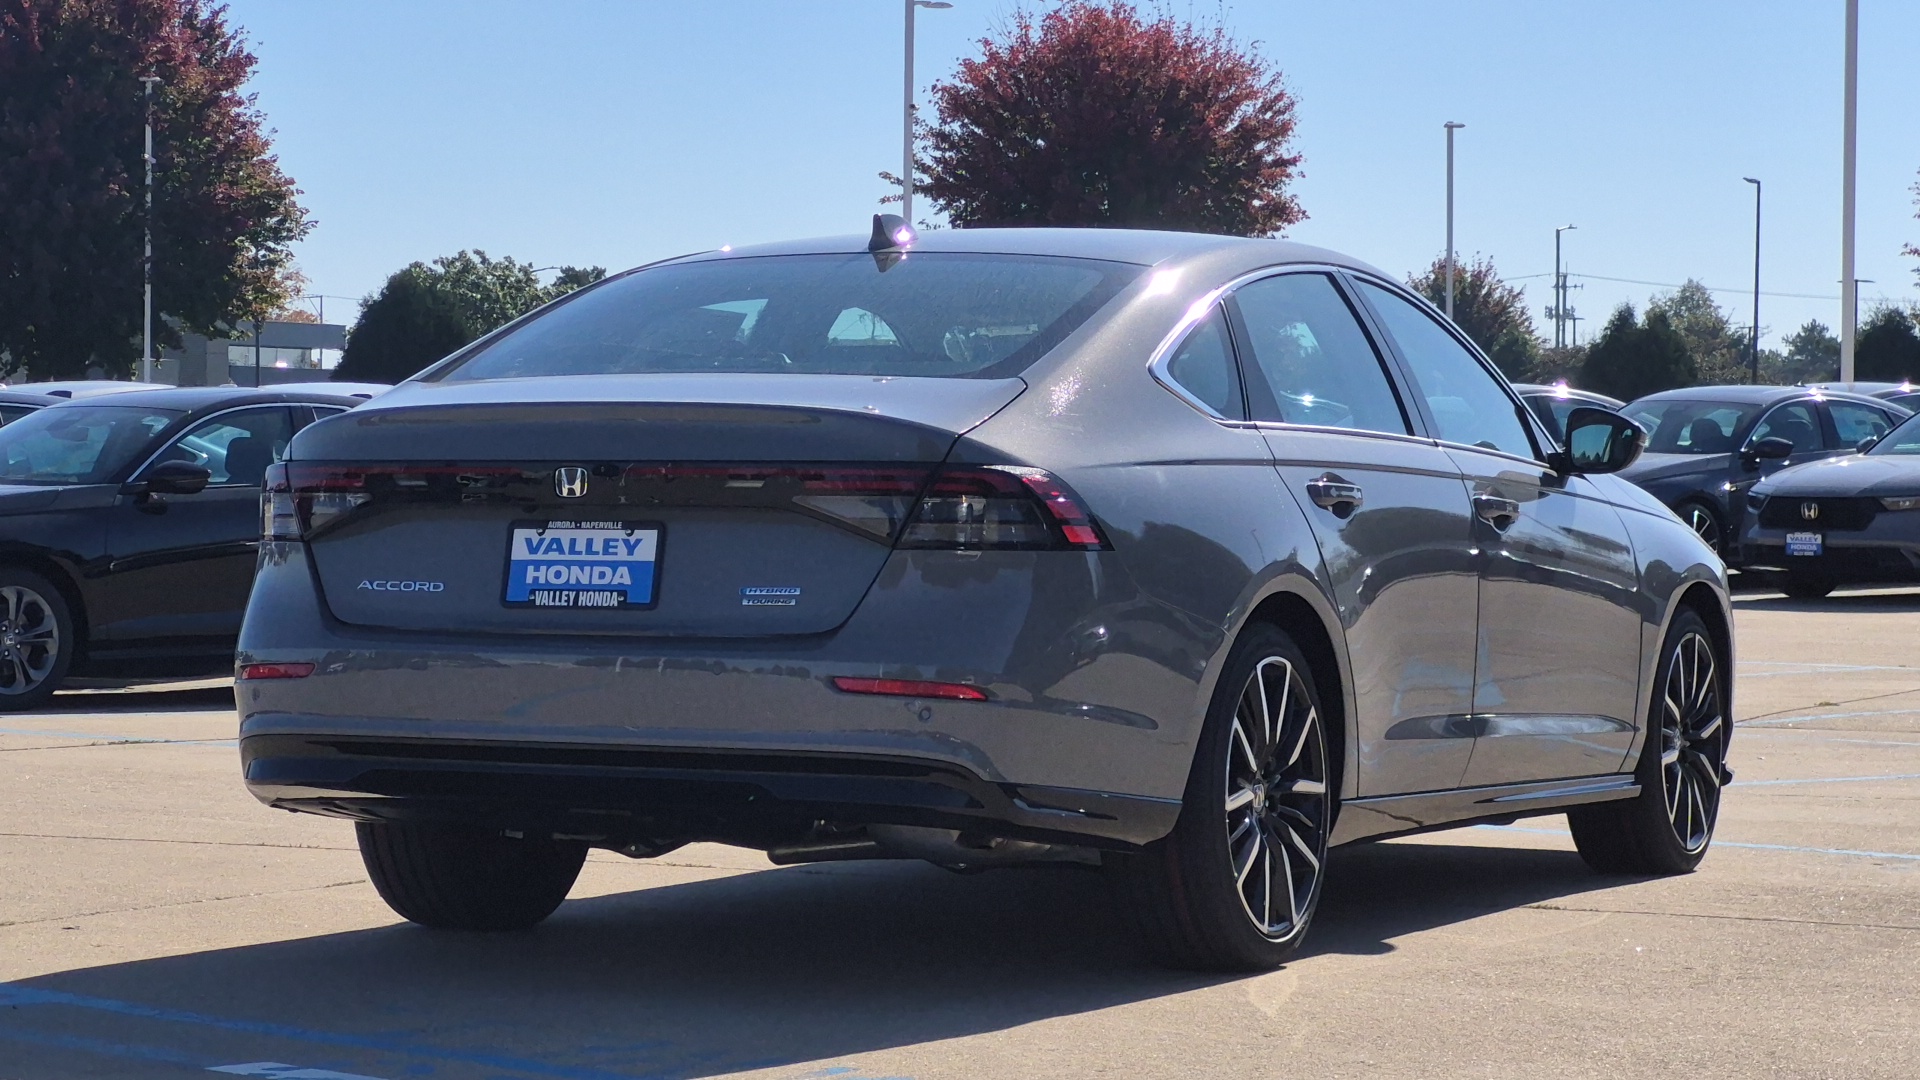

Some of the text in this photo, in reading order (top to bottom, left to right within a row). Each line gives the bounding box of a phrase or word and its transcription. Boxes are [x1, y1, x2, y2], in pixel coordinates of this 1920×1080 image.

[547, 521, 623, 529] AURORA NAPERVILLE
[524, 537, 643, 556] VALLEY
[525, 565, 632, 585] HONDA
[357, 580, 444, 592] ACCORD
[535, 590, 618, 607] VALLEY HONDA
